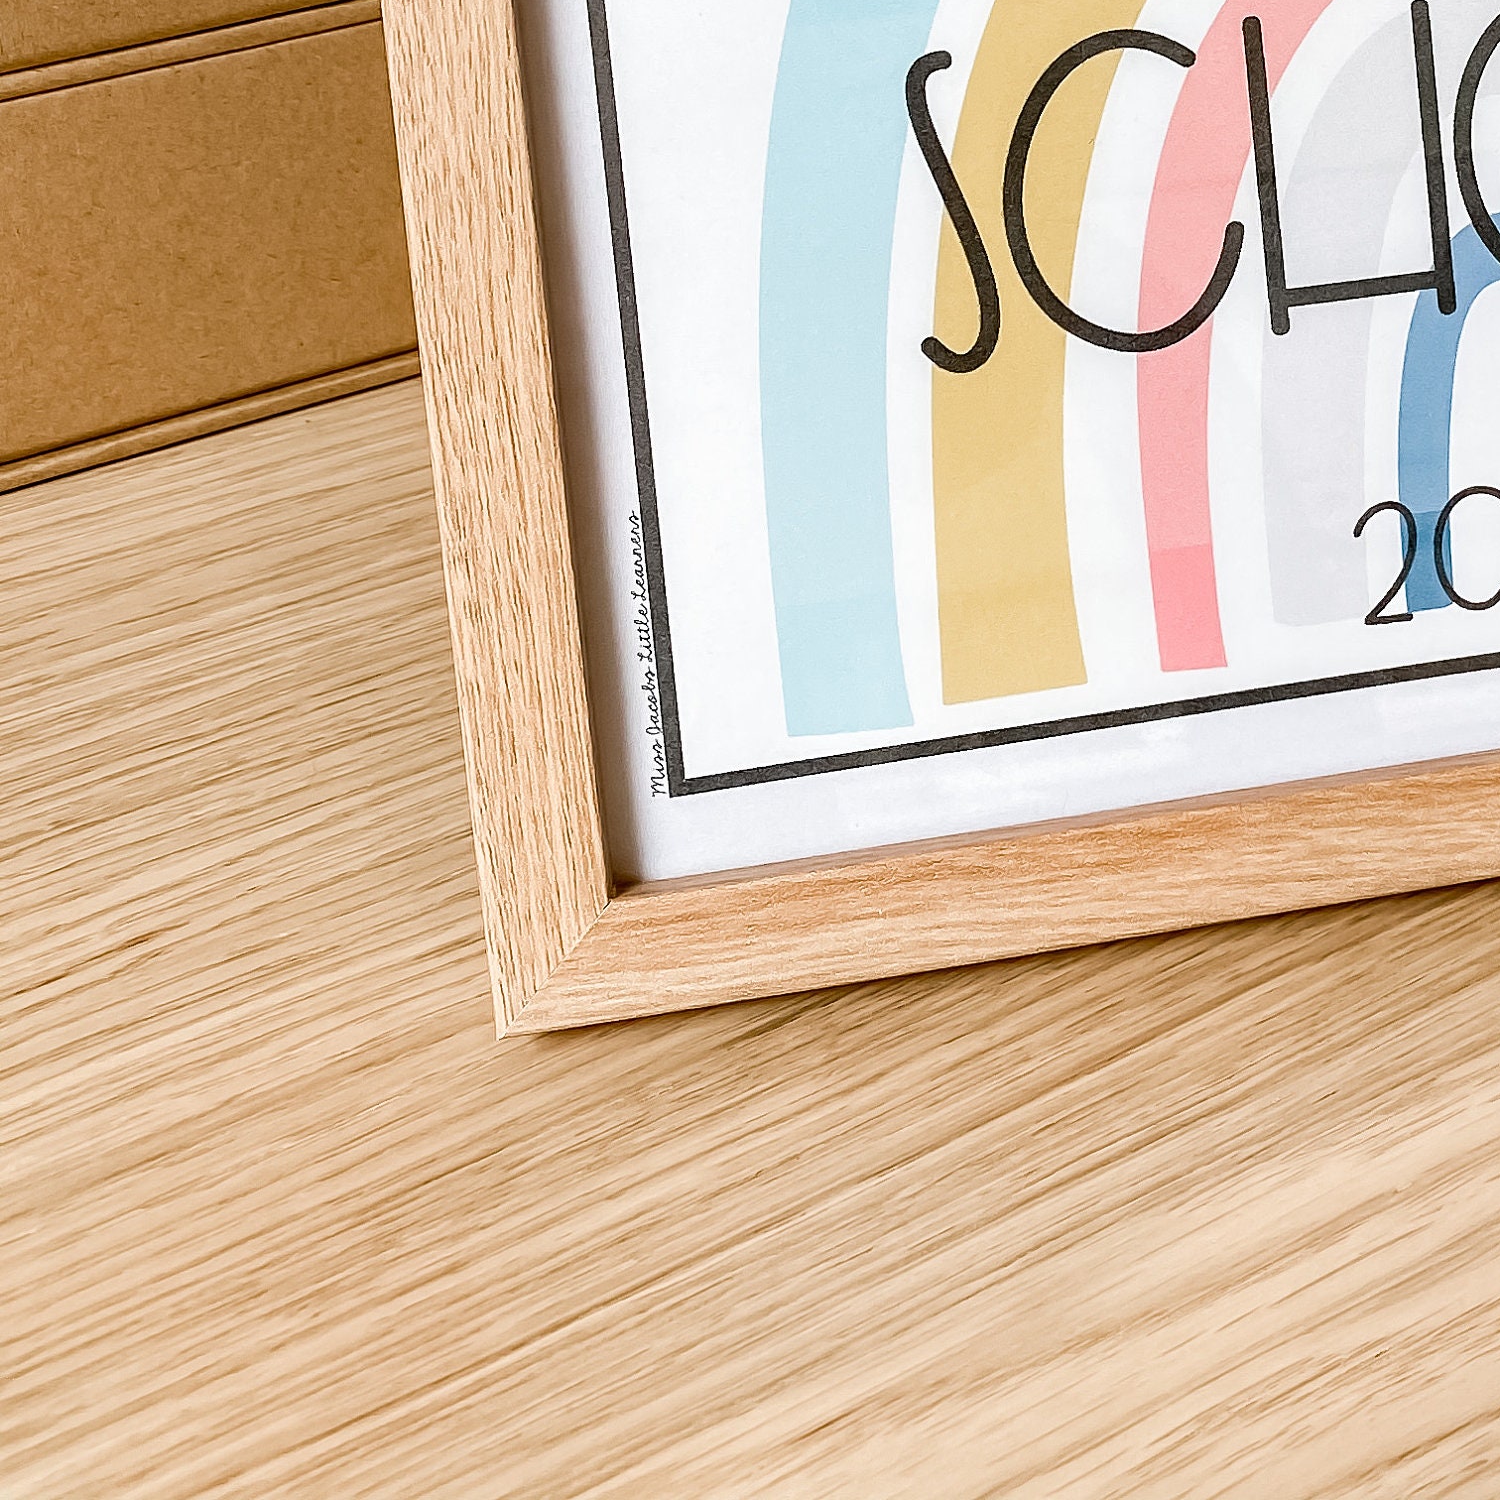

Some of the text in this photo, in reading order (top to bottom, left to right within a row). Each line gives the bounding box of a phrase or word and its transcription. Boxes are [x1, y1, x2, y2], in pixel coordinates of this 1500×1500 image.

[628, 510, 668, 798] Miss Jacobs Little Learners
